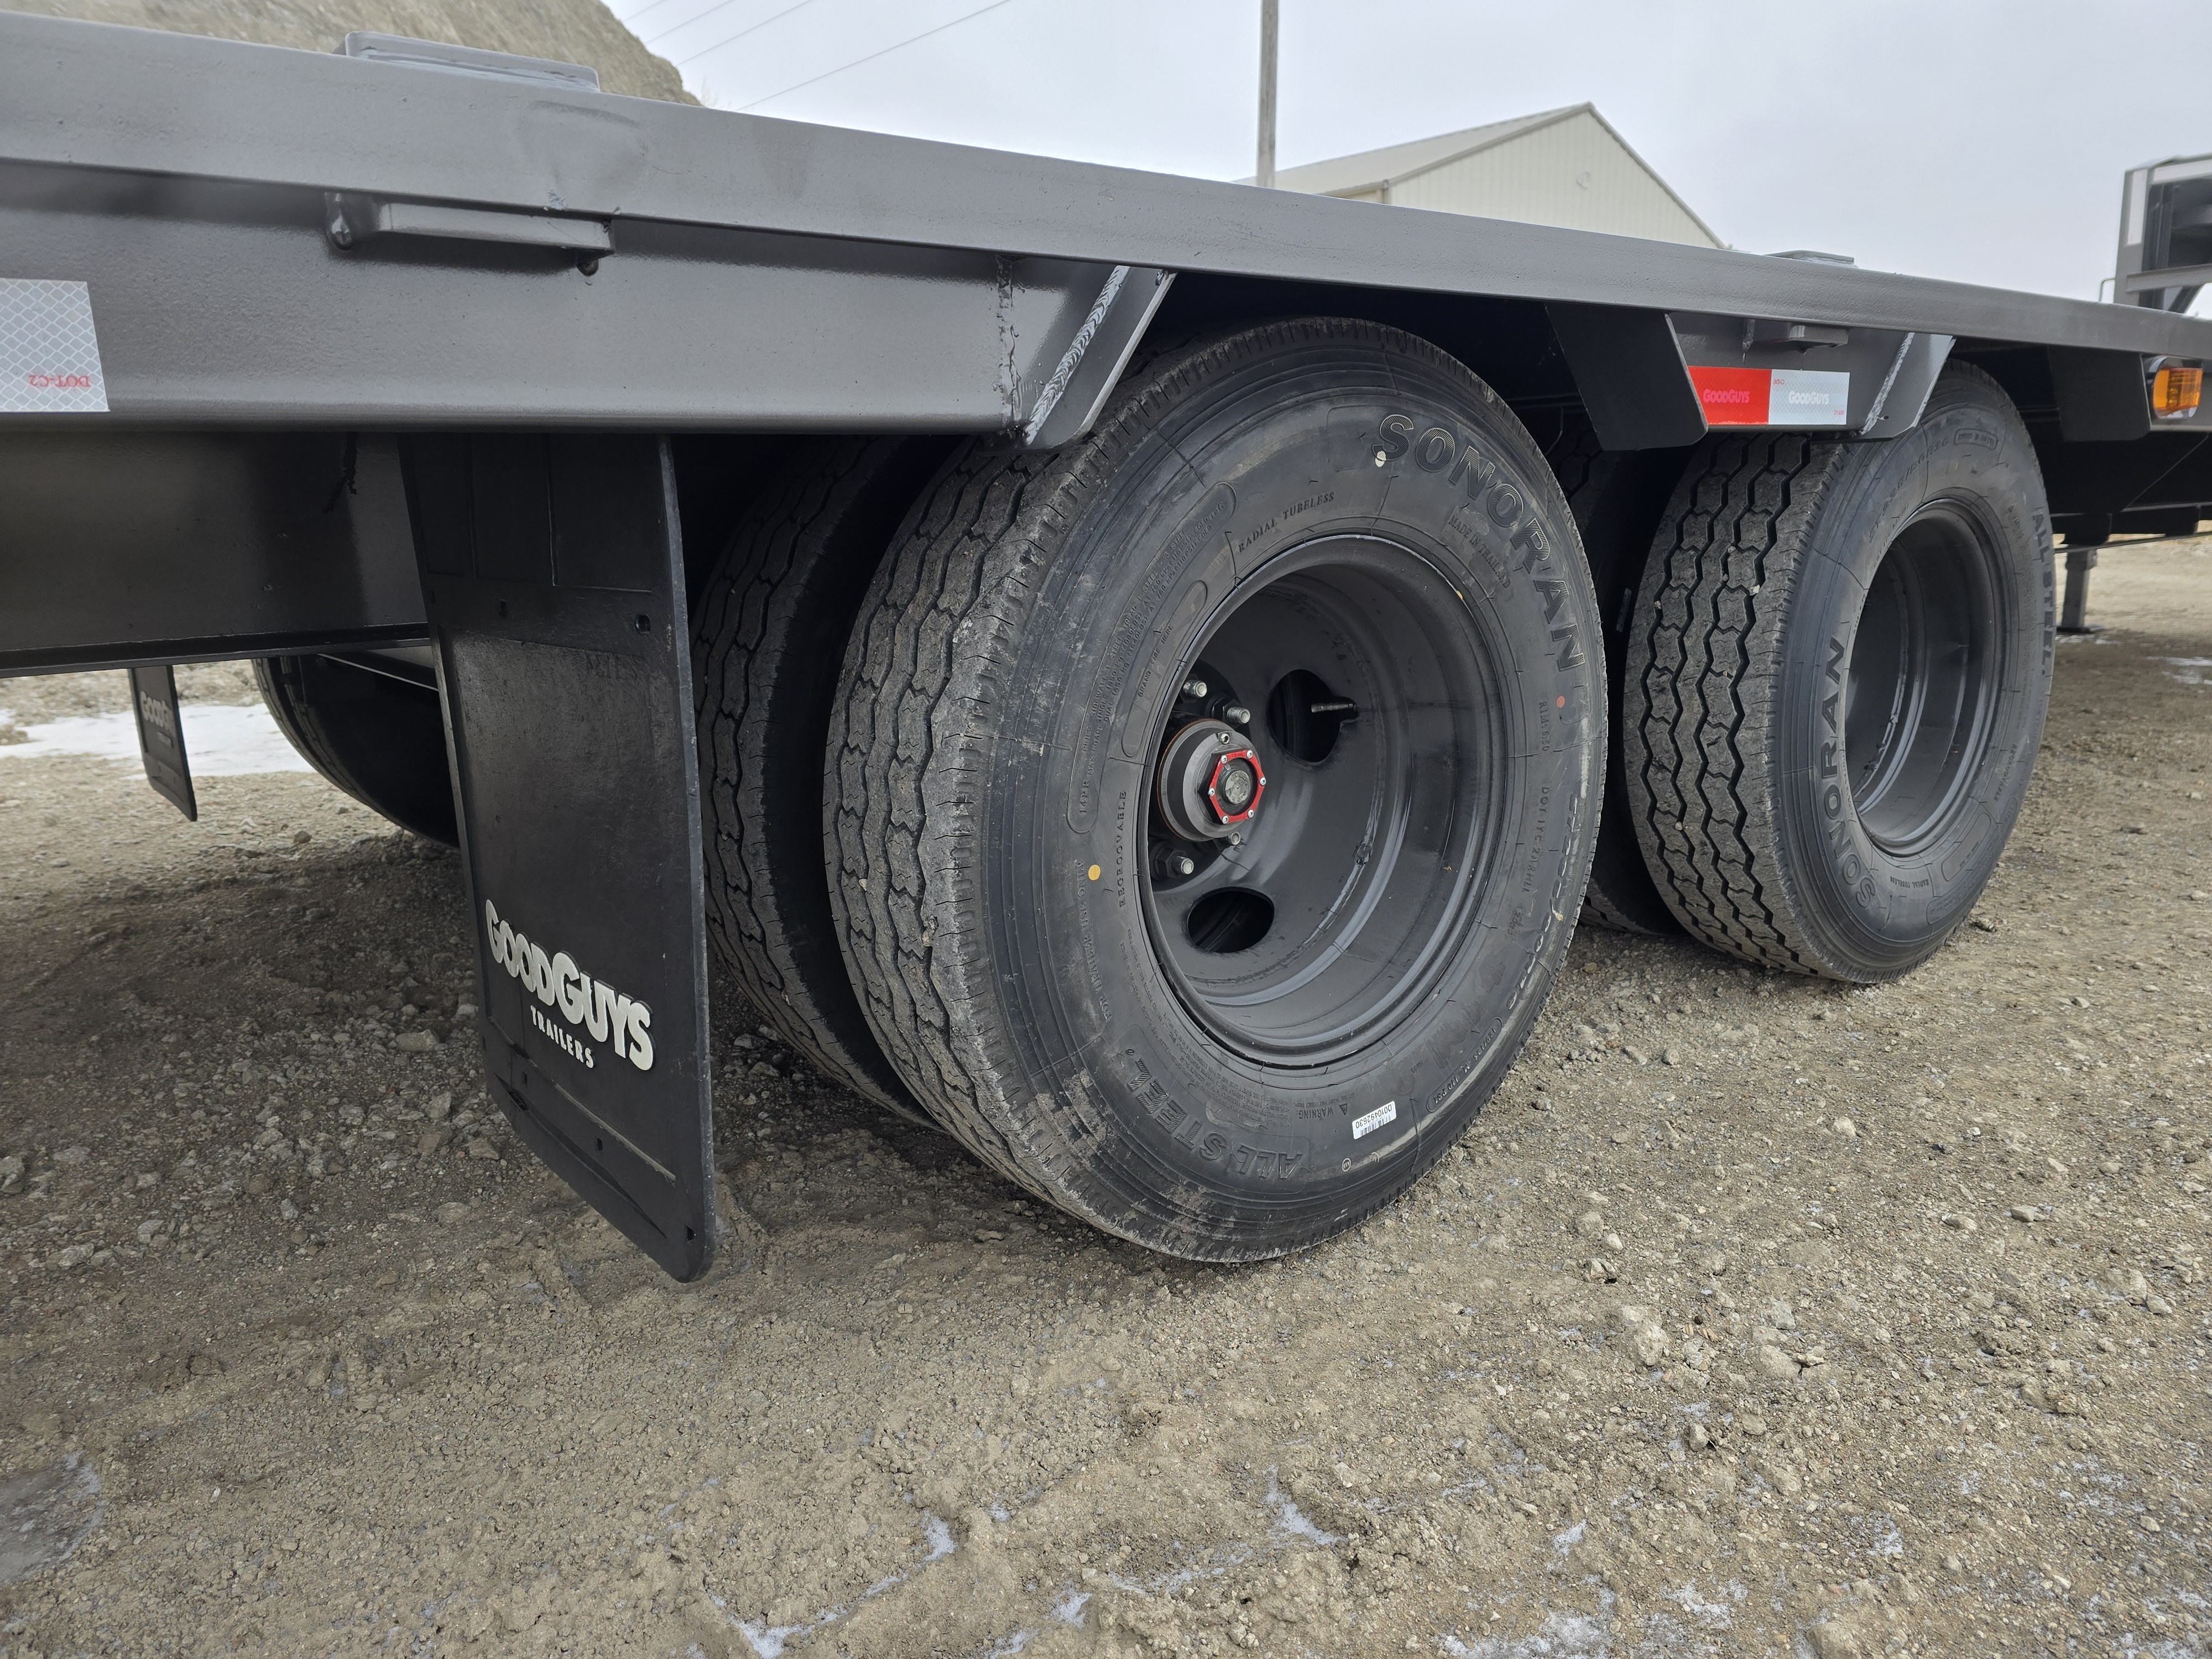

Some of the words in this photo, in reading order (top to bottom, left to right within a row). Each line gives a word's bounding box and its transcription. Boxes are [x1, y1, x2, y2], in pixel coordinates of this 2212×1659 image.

[29, 374, 91, 388] DOT-C2
[1238, 518, 1277, 553] RADIAL
[1282, 491, 1335, 521] TUBELESS
[1448, 515, 1472, 539] MADE
[1468, 533, 1481, 547] IN
[1371, 414, 1585, 671] SONORAN
[1821, 637, 1876, 909] SONORAN
[1540, 785, 1550, 812] DOT
[486, 899, 653, 1071] GOODGUYS
[530, 1005, 593, 1068] TRAILERS
[1296, 1107, 1333, 1119] WARNING:
[1355, 1104, 1392, 1128] D010492630
[1240, 1142, 1303, 1180] ALL
